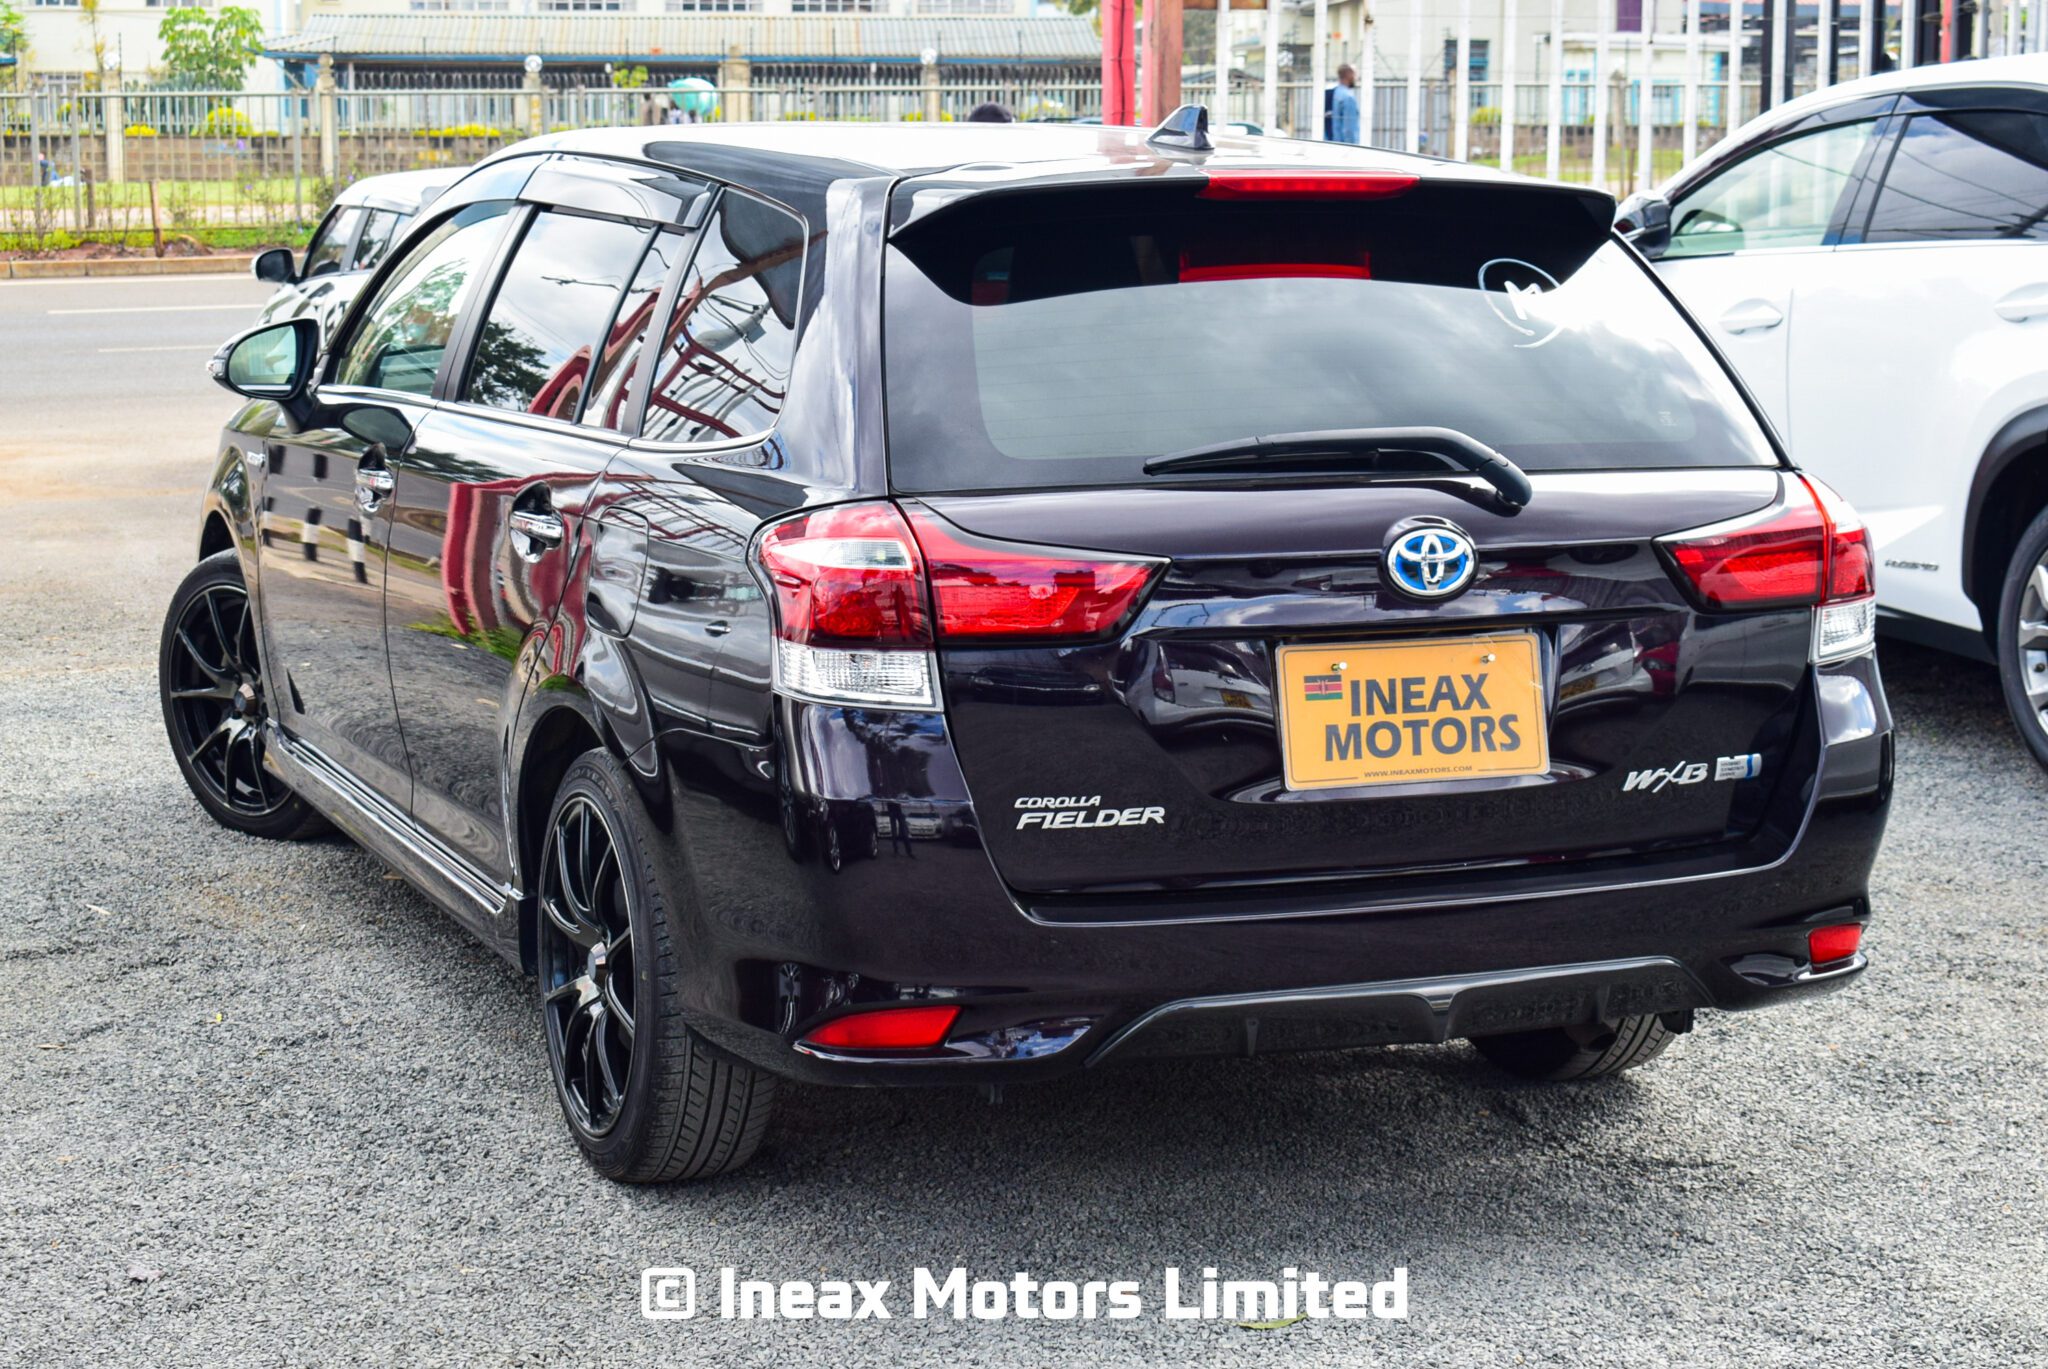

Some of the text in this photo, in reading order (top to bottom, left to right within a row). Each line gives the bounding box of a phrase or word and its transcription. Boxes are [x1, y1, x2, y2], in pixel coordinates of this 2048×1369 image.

[1350, 673, 1492, 717] INEAX
[1325, 714, 1521, 762] MOTORS
[1363, 765, 1473, 777] WWW.INEAXMOTORS.COM
[1014, 796, 1101, 808] COROLLA
[1016, 806, 1165, 830] FIELDER
